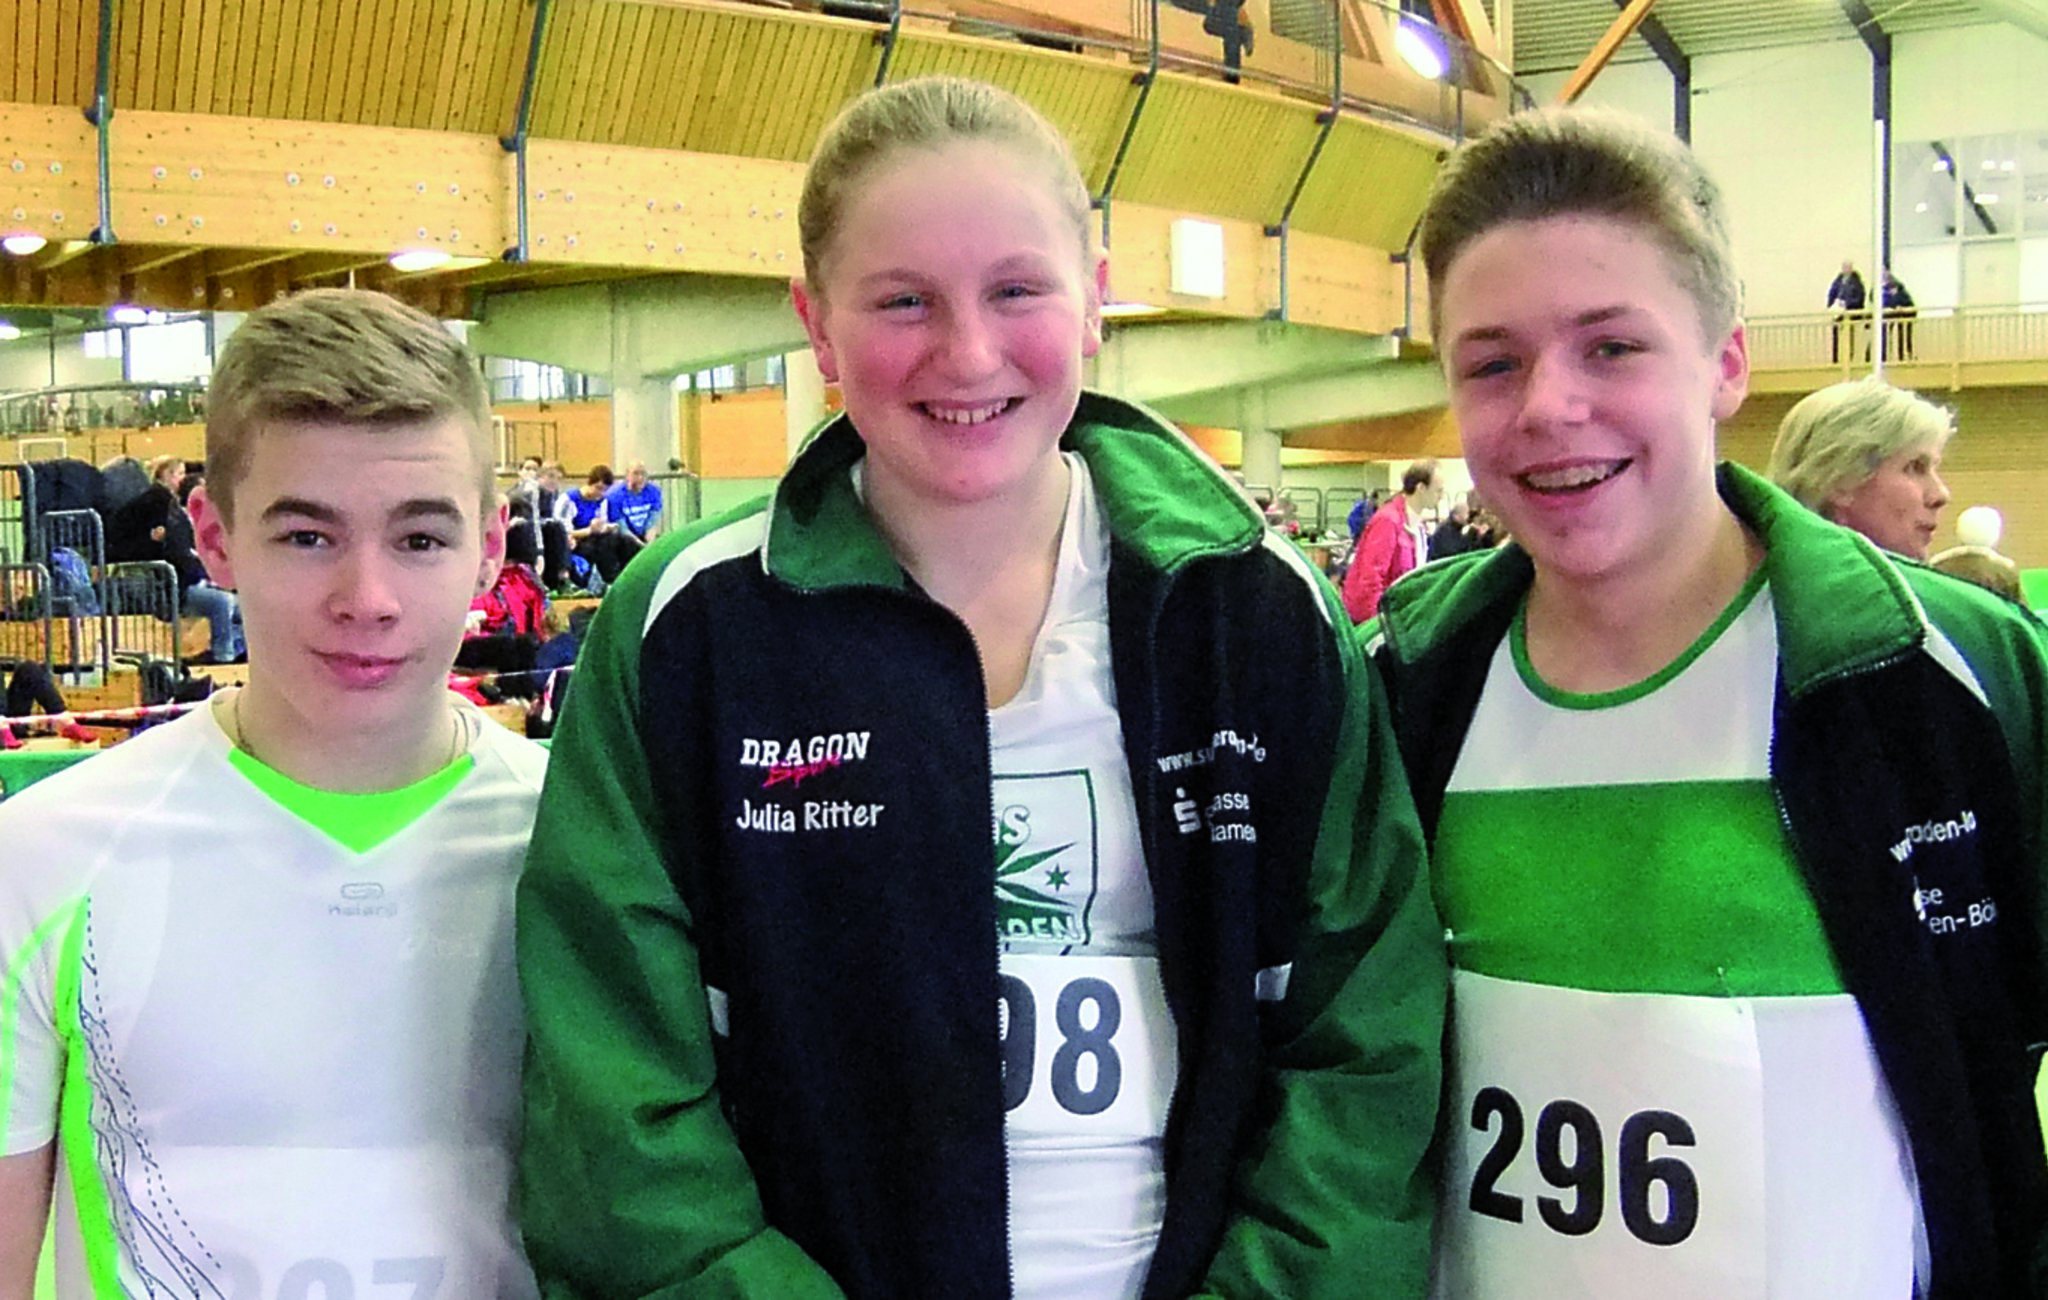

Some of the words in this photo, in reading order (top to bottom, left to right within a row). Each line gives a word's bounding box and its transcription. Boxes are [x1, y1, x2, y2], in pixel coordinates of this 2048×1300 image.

[740, 731, 870, 767] DRAGON
[736, 799, 796, 832] Julia
[804, 800, 885, 830] Ritter
[1469, 1086, 1699, 1246] 296
